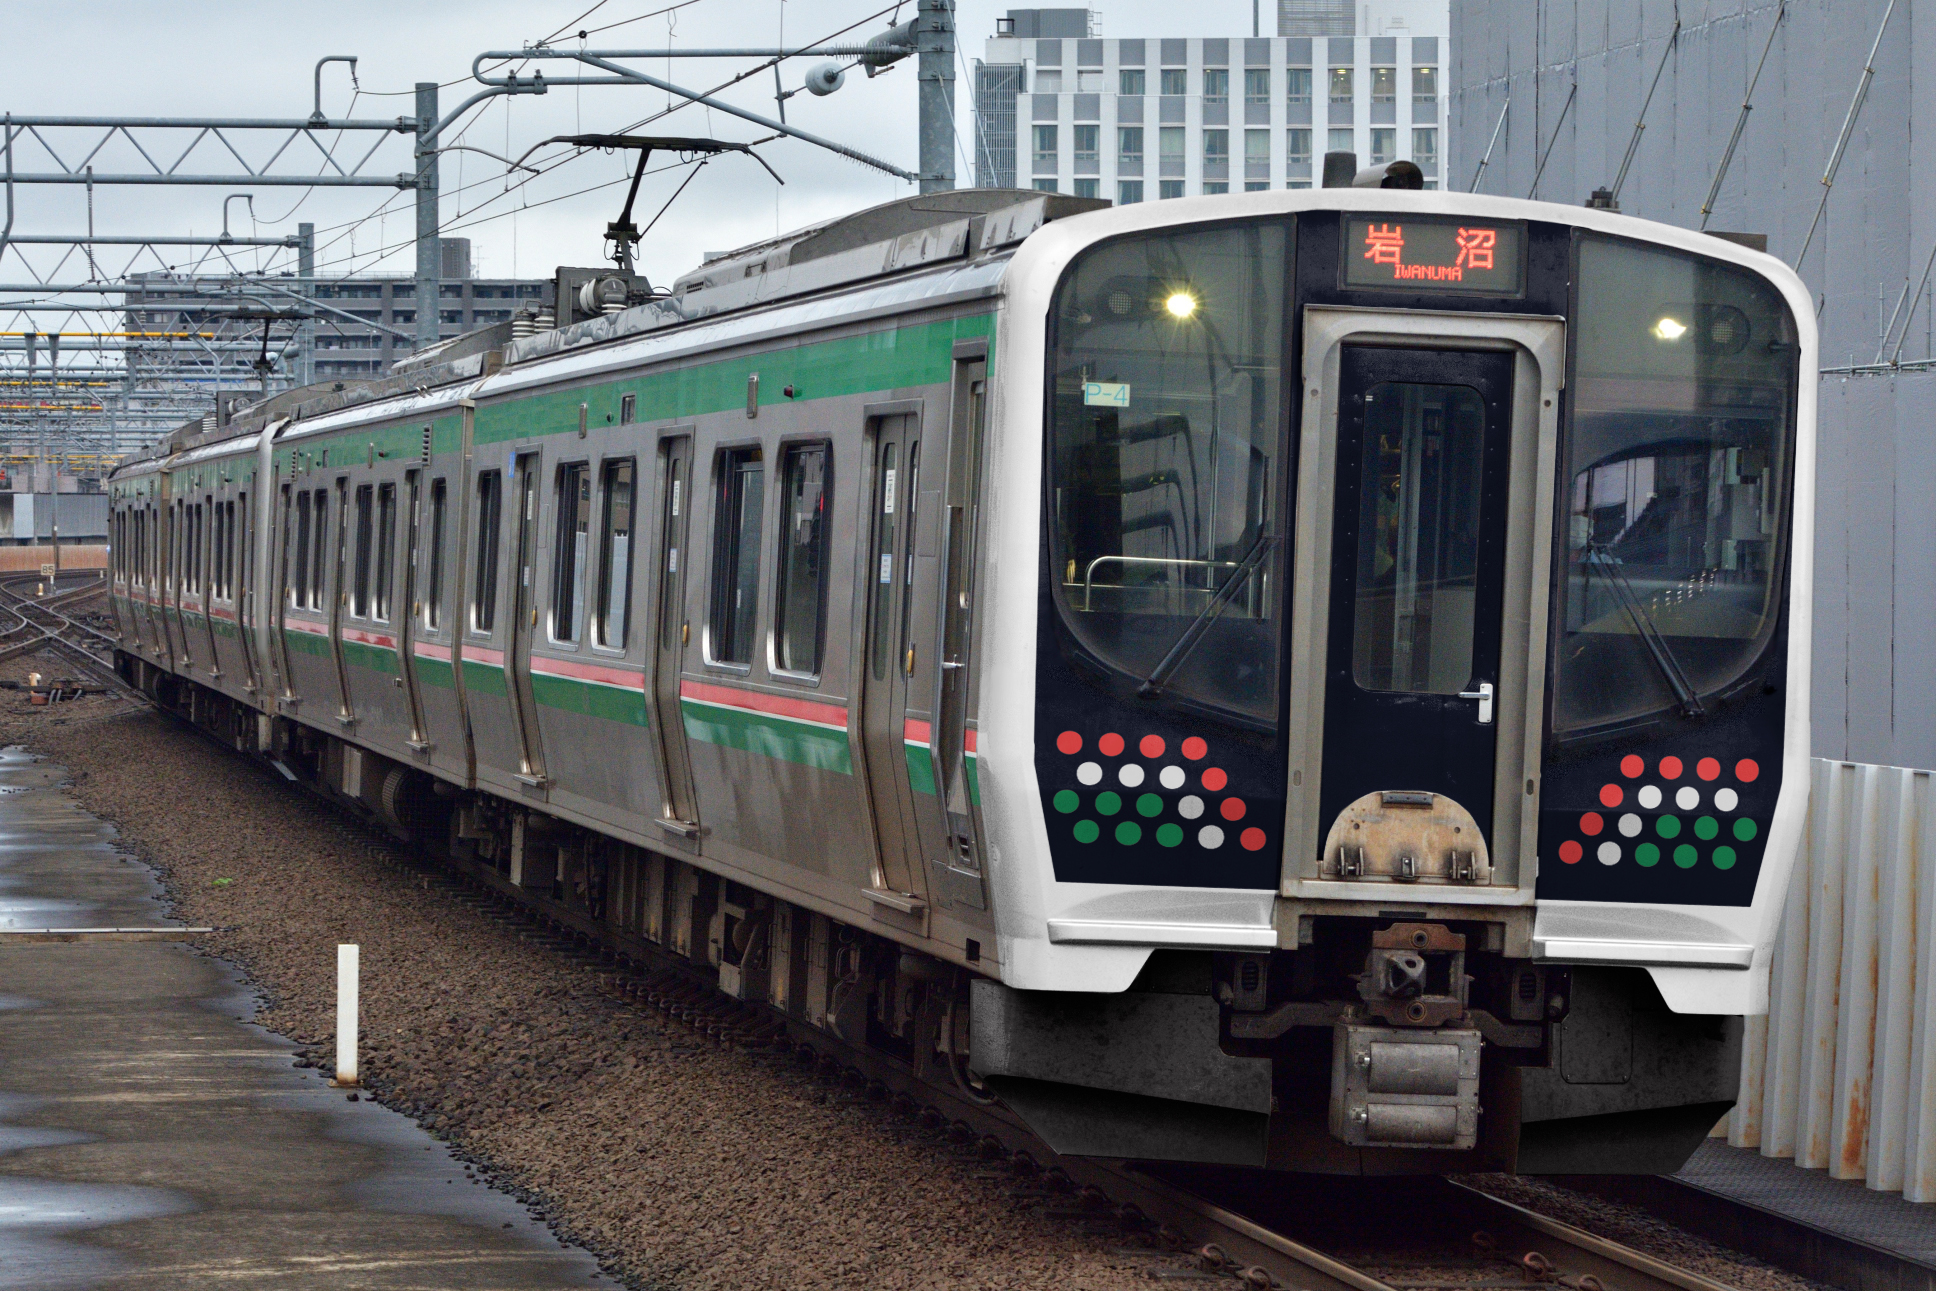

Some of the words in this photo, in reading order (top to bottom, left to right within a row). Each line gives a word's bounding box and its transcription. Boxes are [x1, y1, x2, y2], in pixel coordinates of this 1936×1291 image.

[1364, 223, 1496, 270] 岩沼
[1394, 264, 1462, 281] IWANUMA
[1085, 383, 1127, 405] P-4
